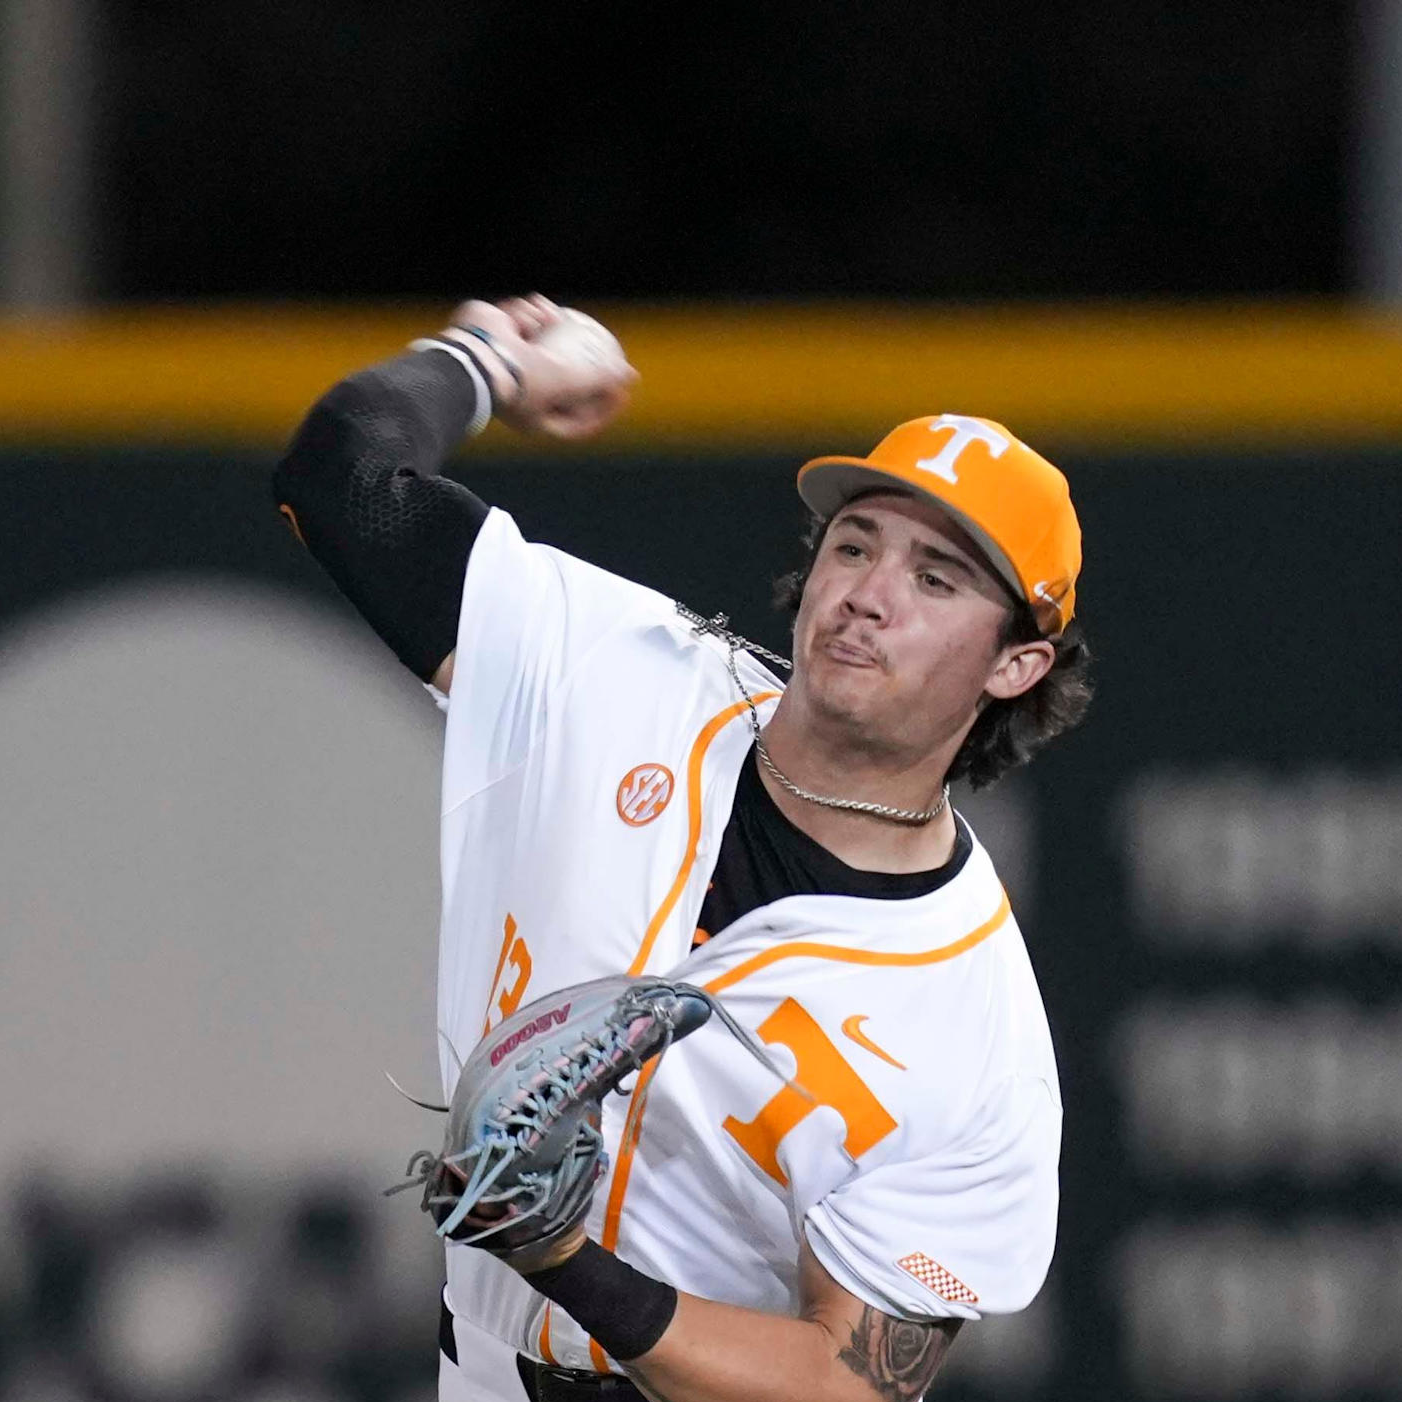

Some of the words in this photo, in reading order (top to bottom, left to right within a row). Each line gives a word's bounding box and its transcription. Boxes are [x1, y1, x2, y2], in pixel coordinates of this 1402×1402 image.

[915, 412, 1009, 485] T
[489, 1002, 572, 1067] A2000
[721, 995, 898, 1186] T
